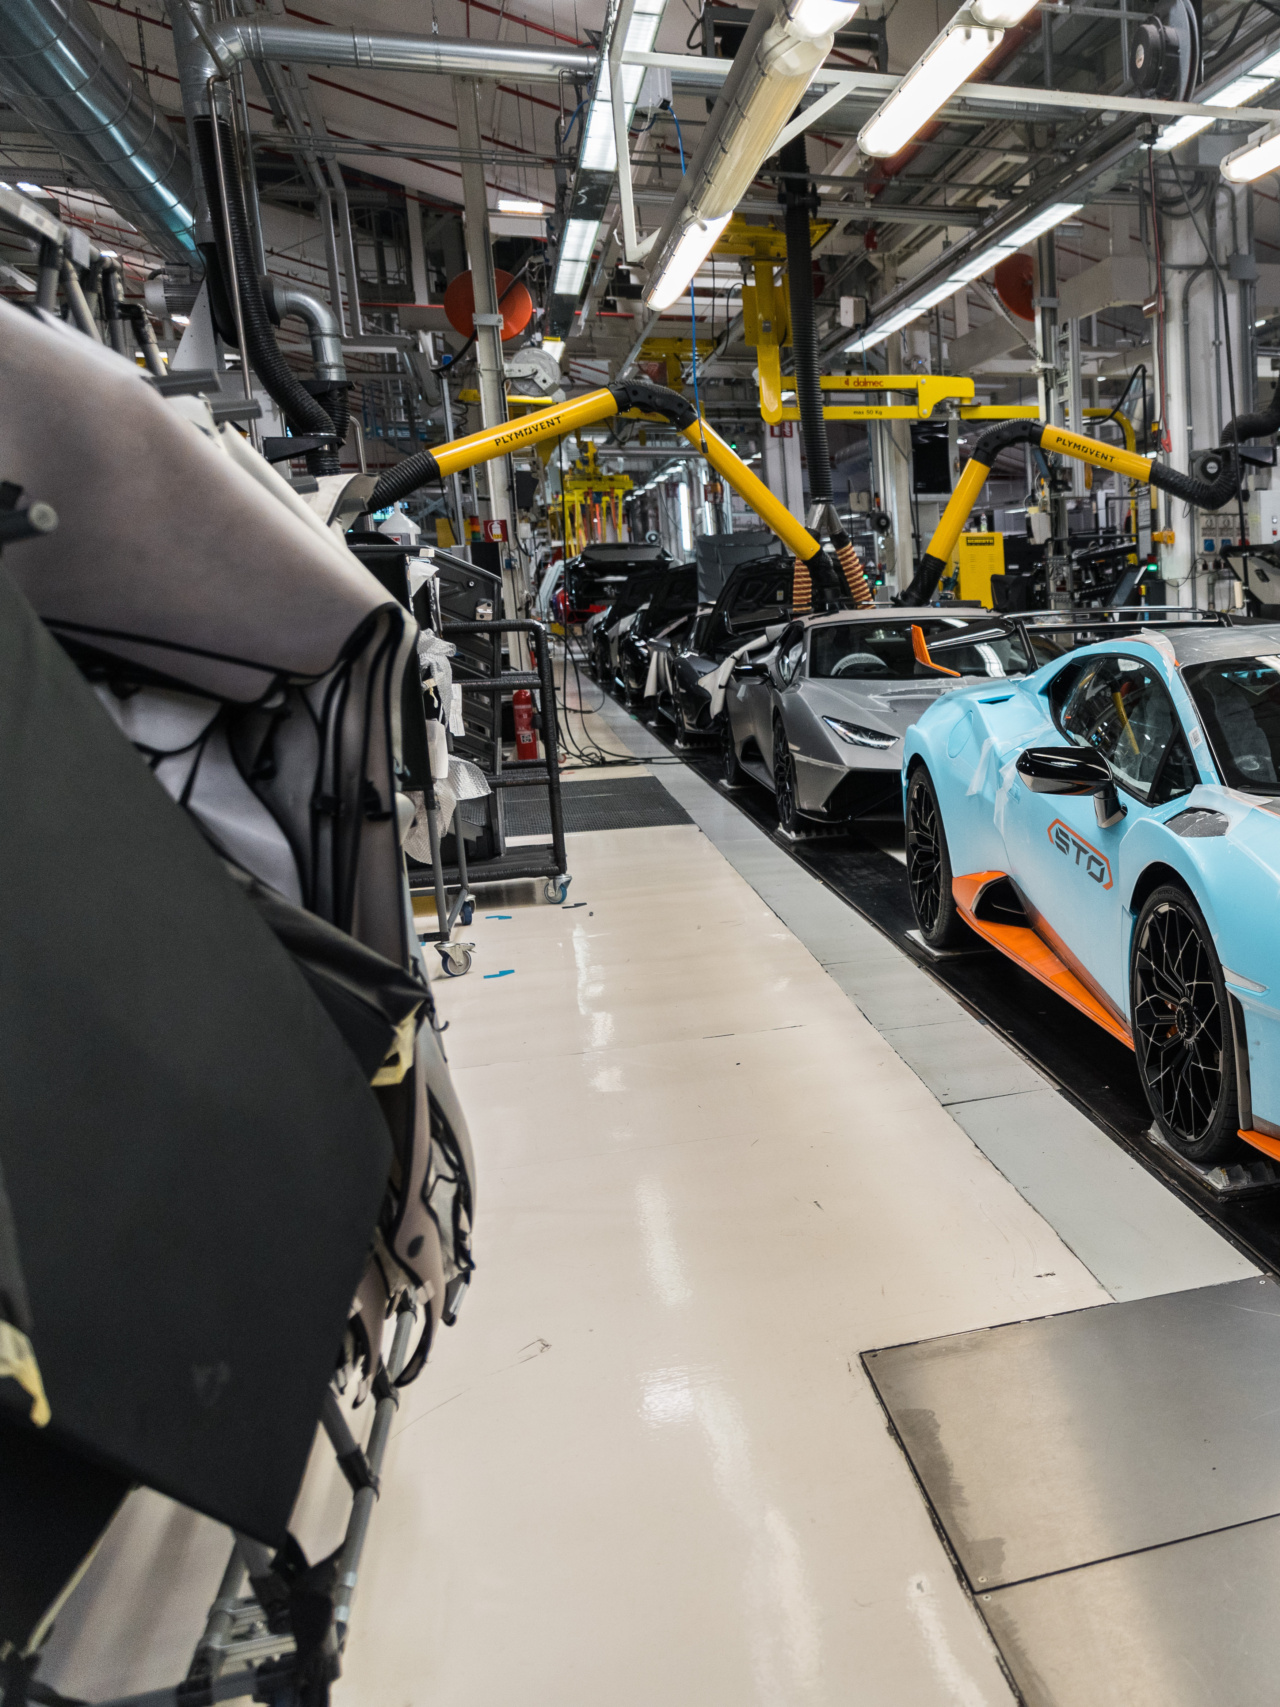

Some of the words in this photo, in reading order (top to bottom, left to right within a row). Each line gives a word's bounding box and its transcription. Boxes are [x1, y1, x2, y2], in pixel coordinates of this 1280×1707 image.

[853, 377, 884, 388] dalmec
[494, 415, 561, 446] PLYMOVENT
[1055, 436, 1116, 463] PLYMOVENT
[1054, 826, 1106, 884] STO
